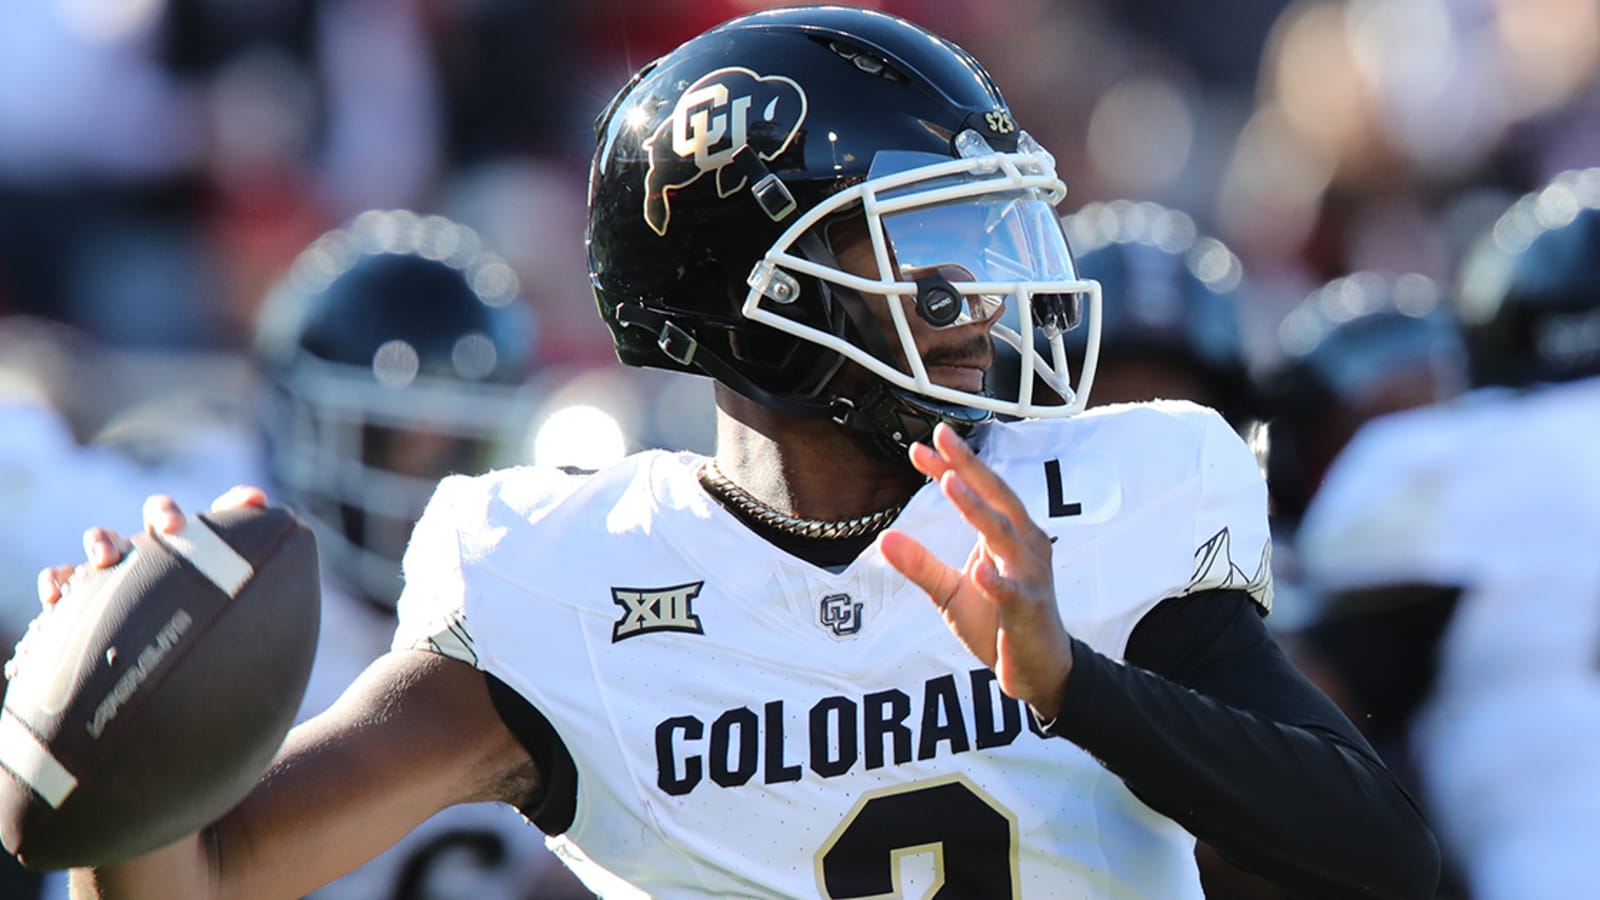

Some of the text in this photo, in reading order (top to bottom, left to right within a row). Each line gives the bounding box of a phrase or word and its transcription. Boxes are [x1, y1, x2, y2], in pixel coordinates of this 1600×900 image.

[673, 83, 752, 168] CU
[1044, 458, 1082, 518] L
[613, 582, 704, 640] XII
[820, 593, 864, 636] CU
[655, 668, 1056, 796] COLORAD
